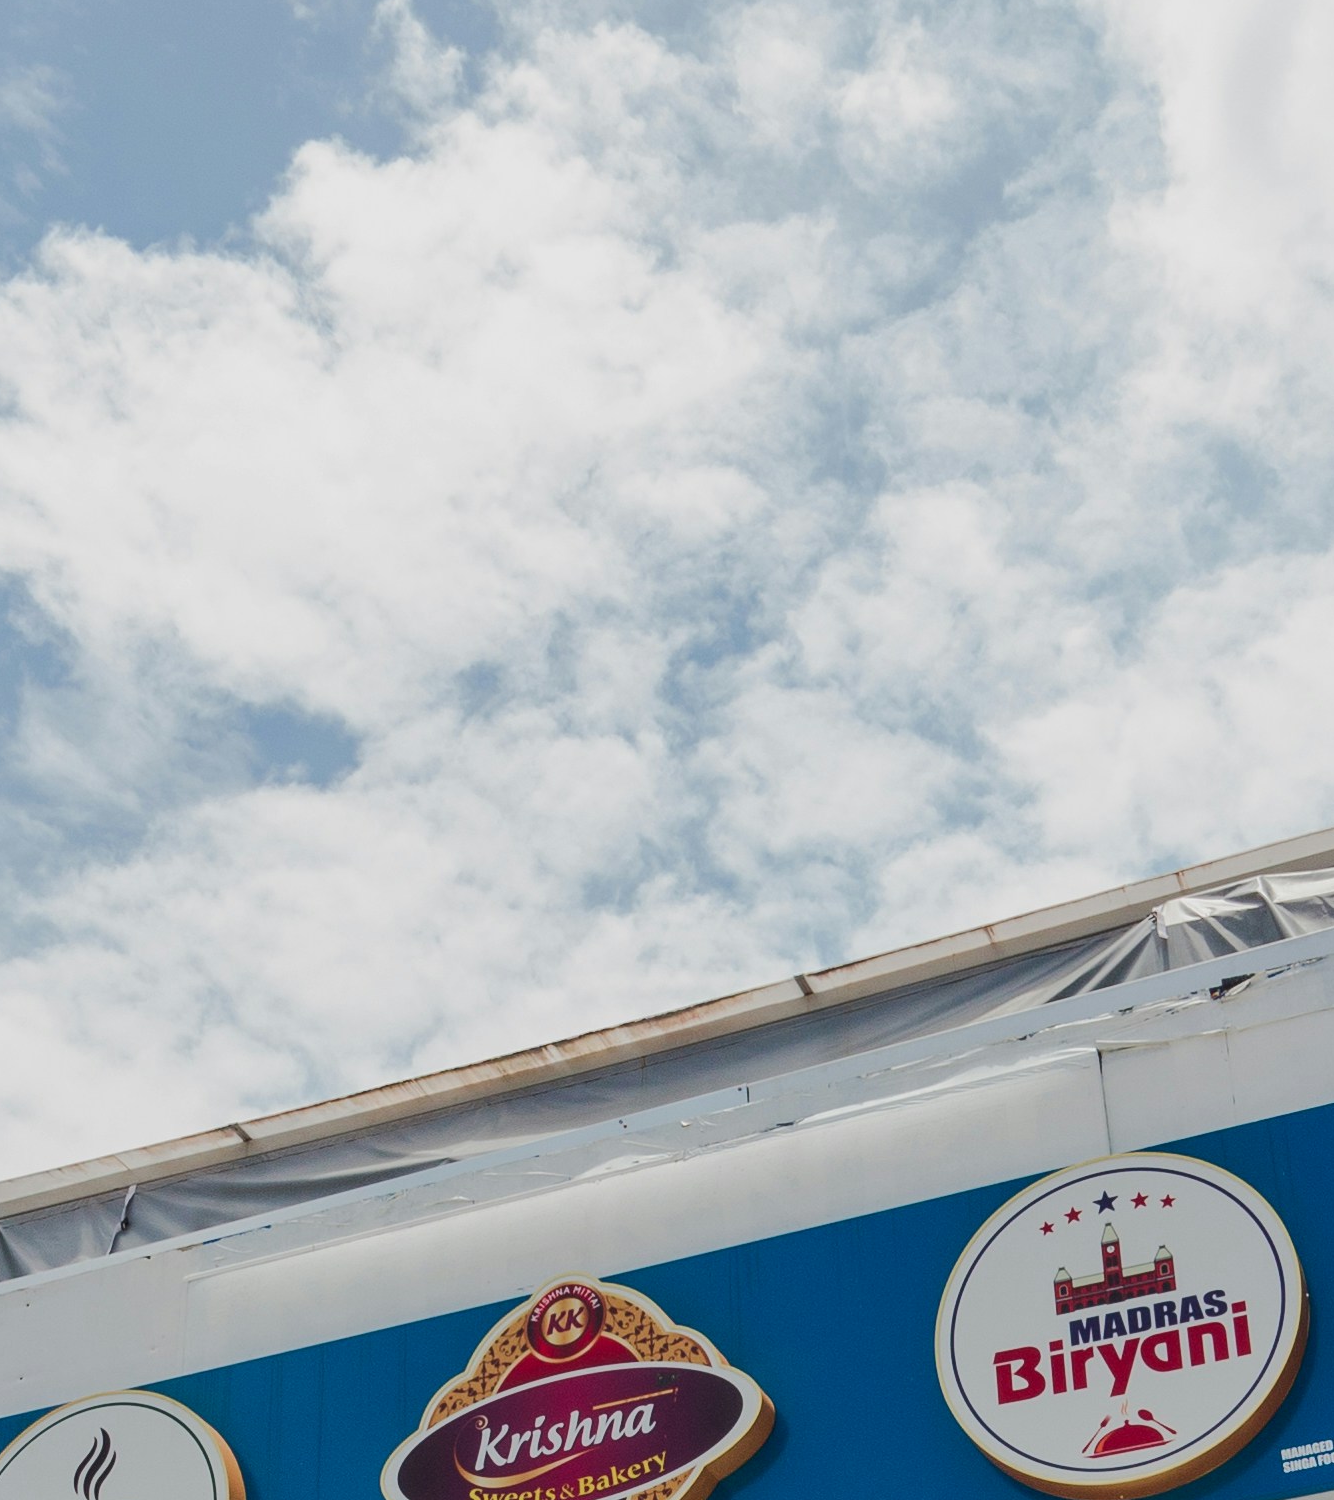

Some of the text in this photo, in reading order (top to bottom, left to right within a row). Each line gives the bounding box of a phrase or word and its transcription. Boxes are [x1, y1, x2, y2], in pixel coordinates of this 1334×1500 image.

[546, 1306, 585, 1336] KK
[1068, 1288, 1229, 1348] MADRAS
[992, 1301, 1253, 1405] Biryani
[474, 1403, 657, 1471] Krishna
[1280, 1438, 1334, 1460] MANAGED
[559, 1484, 576, 1500] &
[577, 1450, 667, 1497] Bakery
[1282, 1460, 1317, 1474] SINGA
